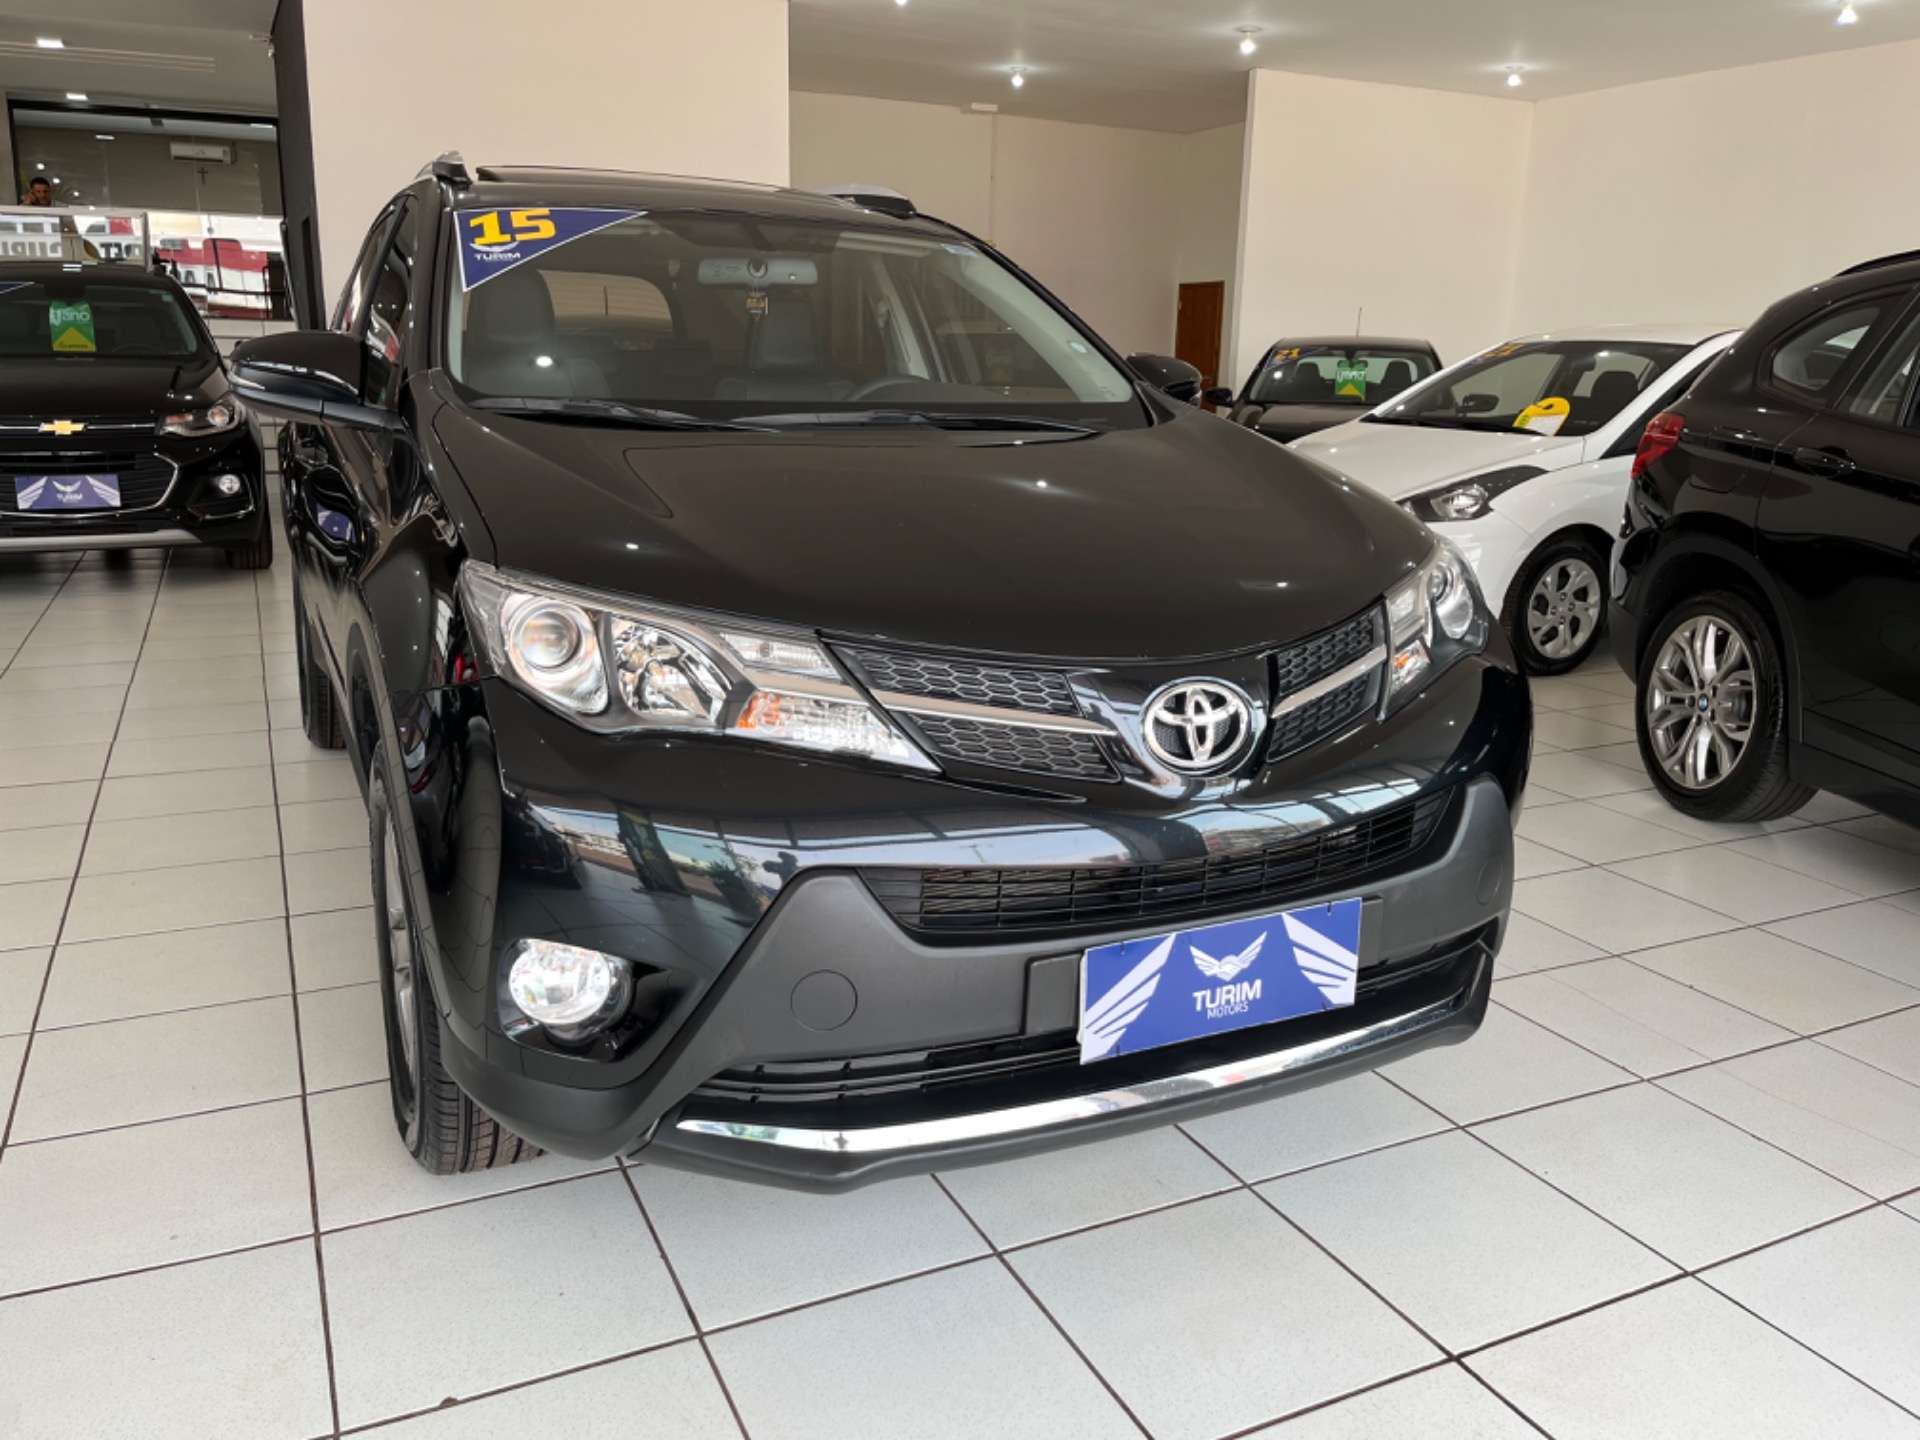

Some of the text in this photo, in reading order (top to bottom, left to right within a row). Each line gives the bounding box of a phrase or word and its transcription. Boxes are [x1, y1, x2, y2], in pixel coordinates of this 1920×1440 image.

[469, 208, 556, 245] 15
[1192, 978, 1262, 1012] TURIM
[1207, 1001, 1249, 1020] MOTORS
